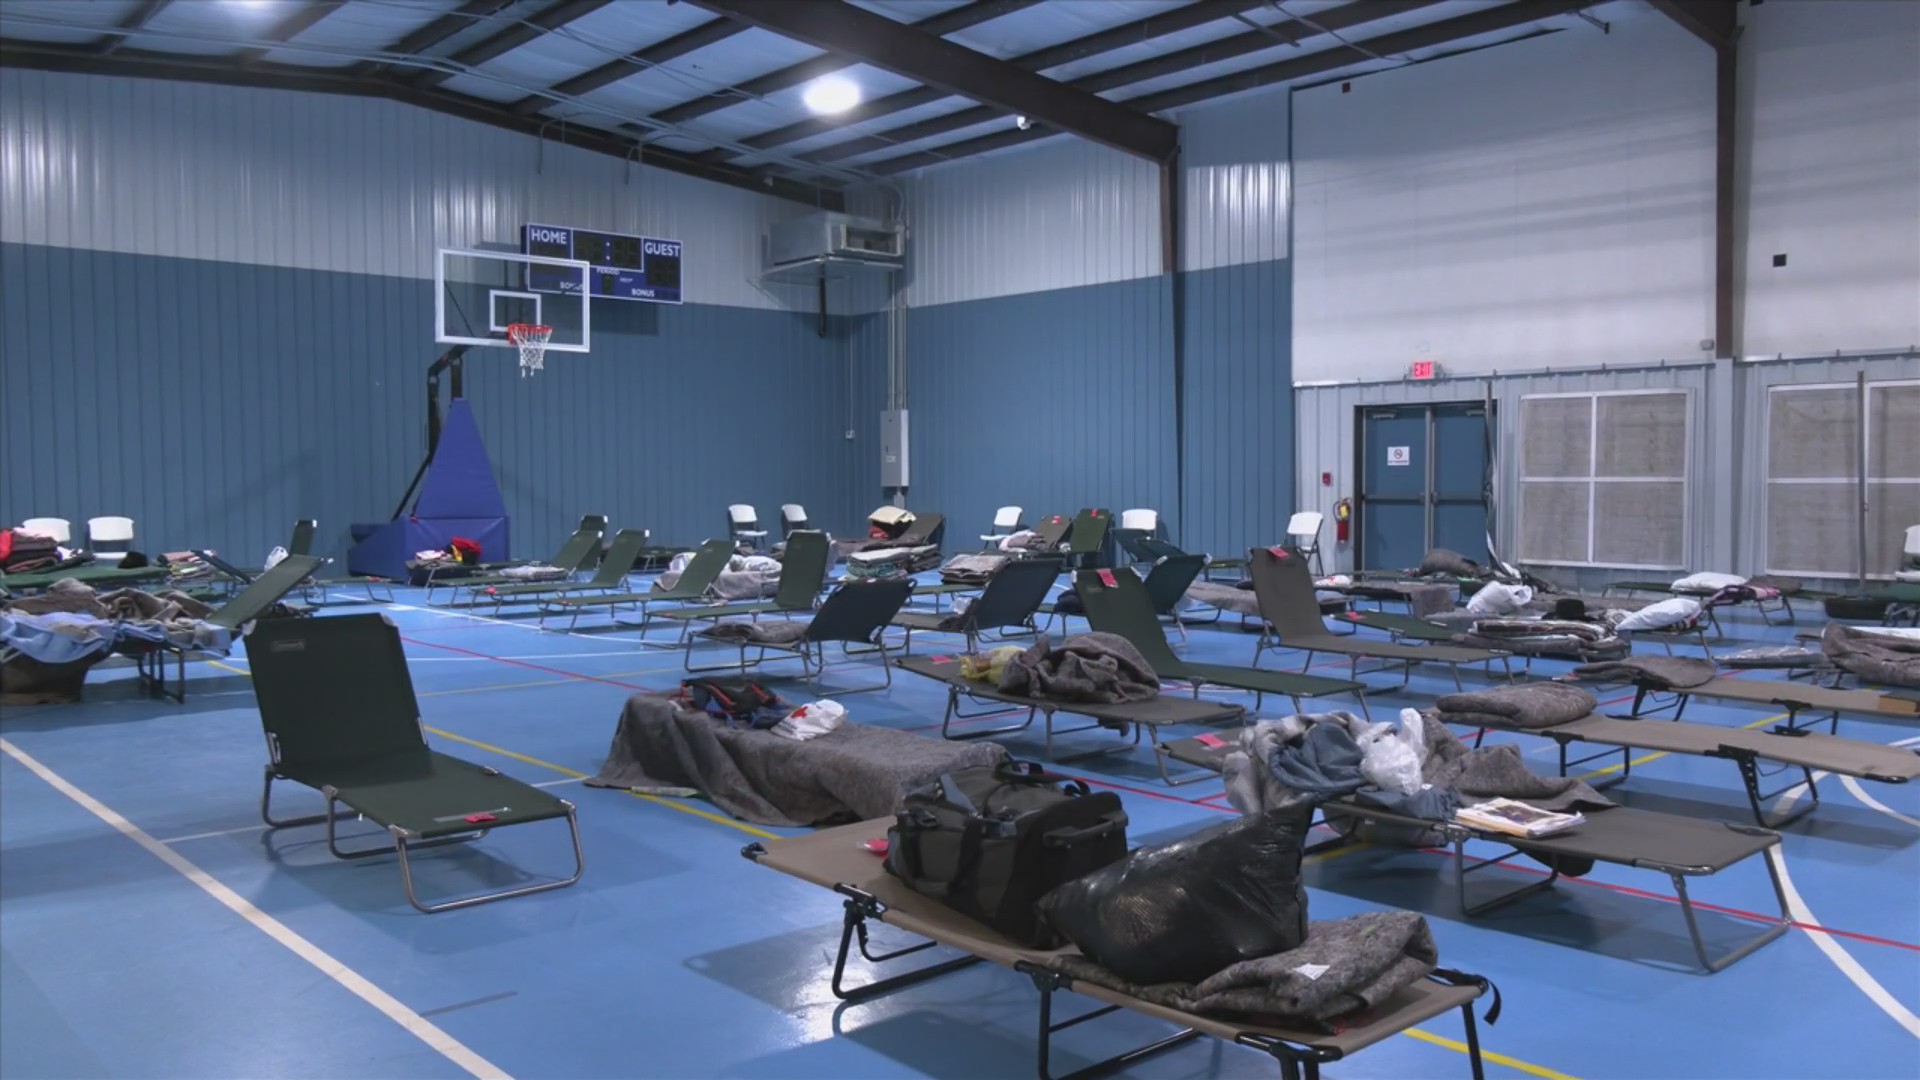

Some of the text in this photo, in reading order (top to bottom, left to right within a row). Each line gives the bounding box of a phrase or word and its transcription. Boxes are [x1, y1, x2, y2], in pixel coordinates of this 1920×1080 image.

[531, 228, 567, 244] HOME
[644, 242, 680, 257] GUEST
[631, 288, 655, 298] BONUS
[1414, 362, 1431, 377] EXIT
